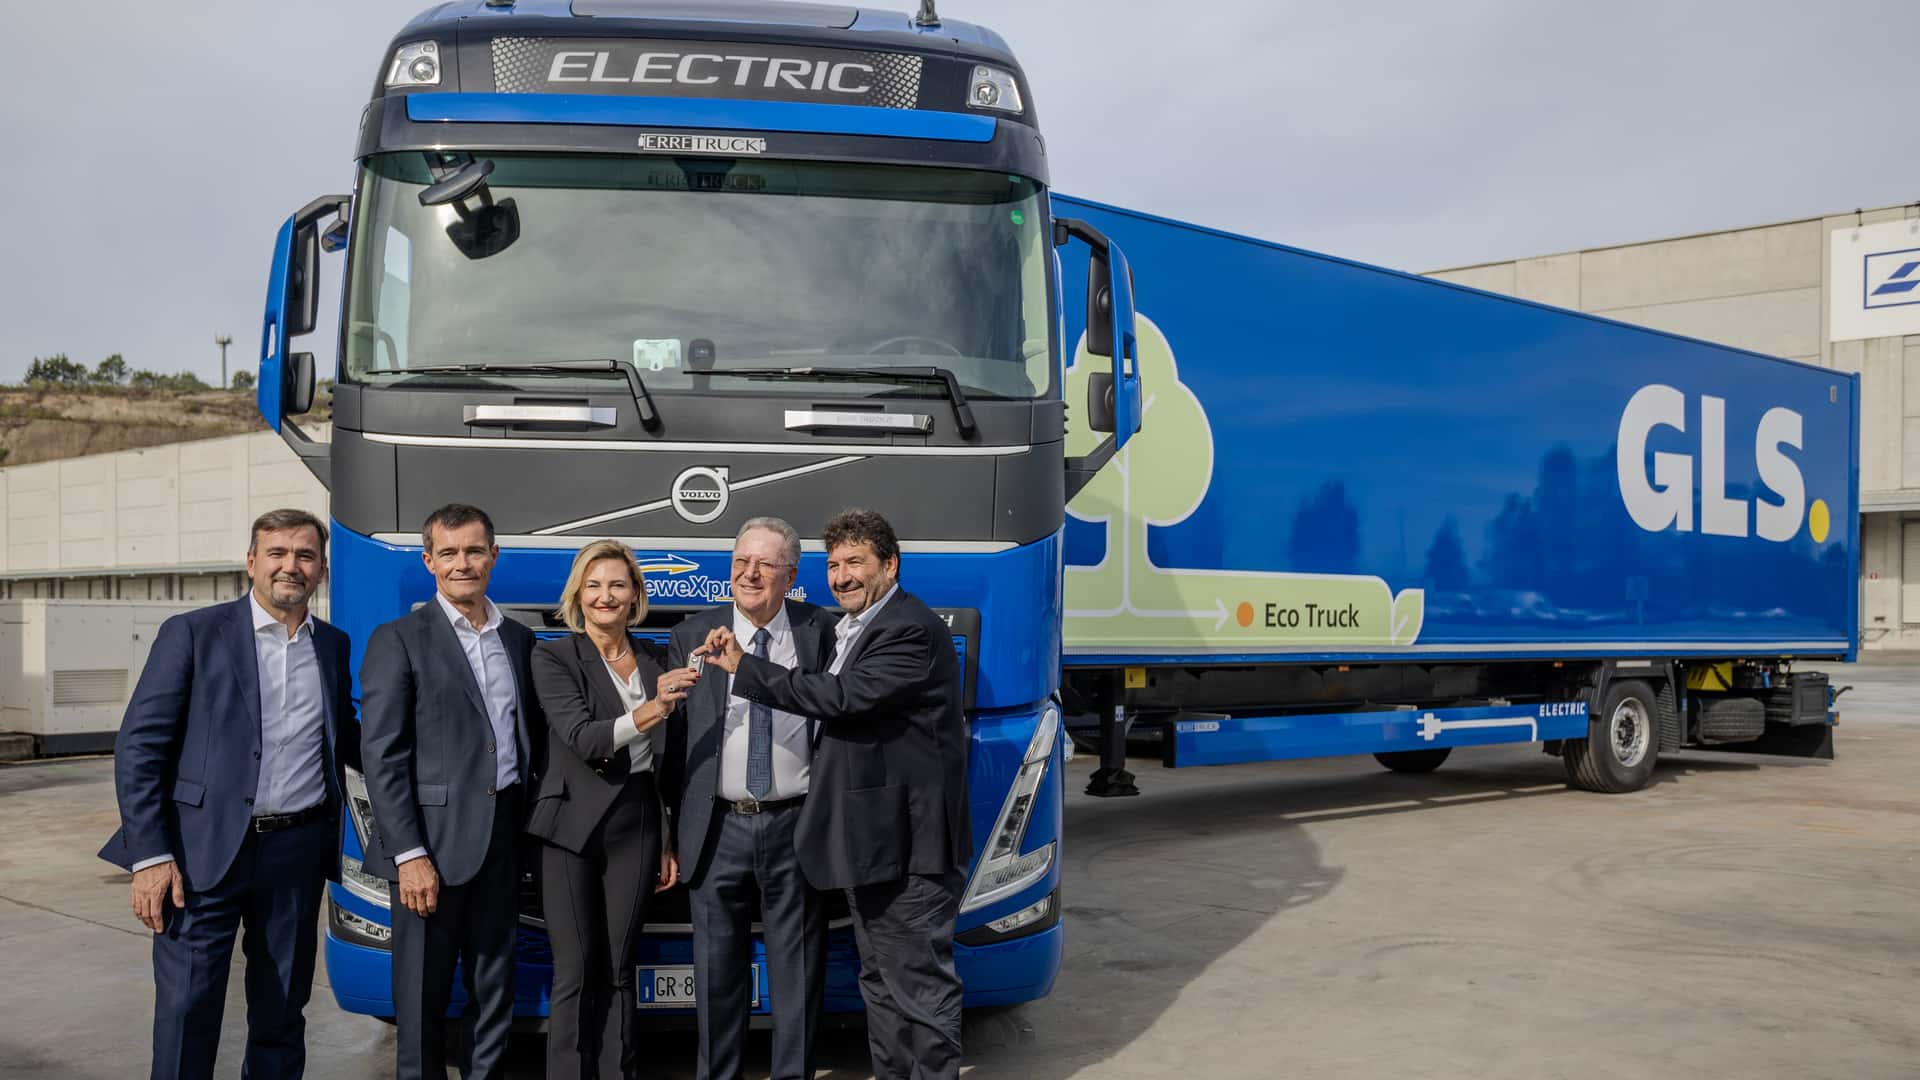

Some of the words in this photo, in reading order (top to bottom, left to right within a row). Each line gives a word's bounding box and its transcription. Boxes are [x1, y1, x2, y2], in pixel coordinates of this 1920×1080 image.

[547, 51, 875, 93] ELECTRIC
[680, 491, 721, 499] VOLVO
[1265, 602, 1300, 628] Eco
[1305, 602, 1360, 628] Truck
[1539, 701, 1586, 718] ELECTRIC
